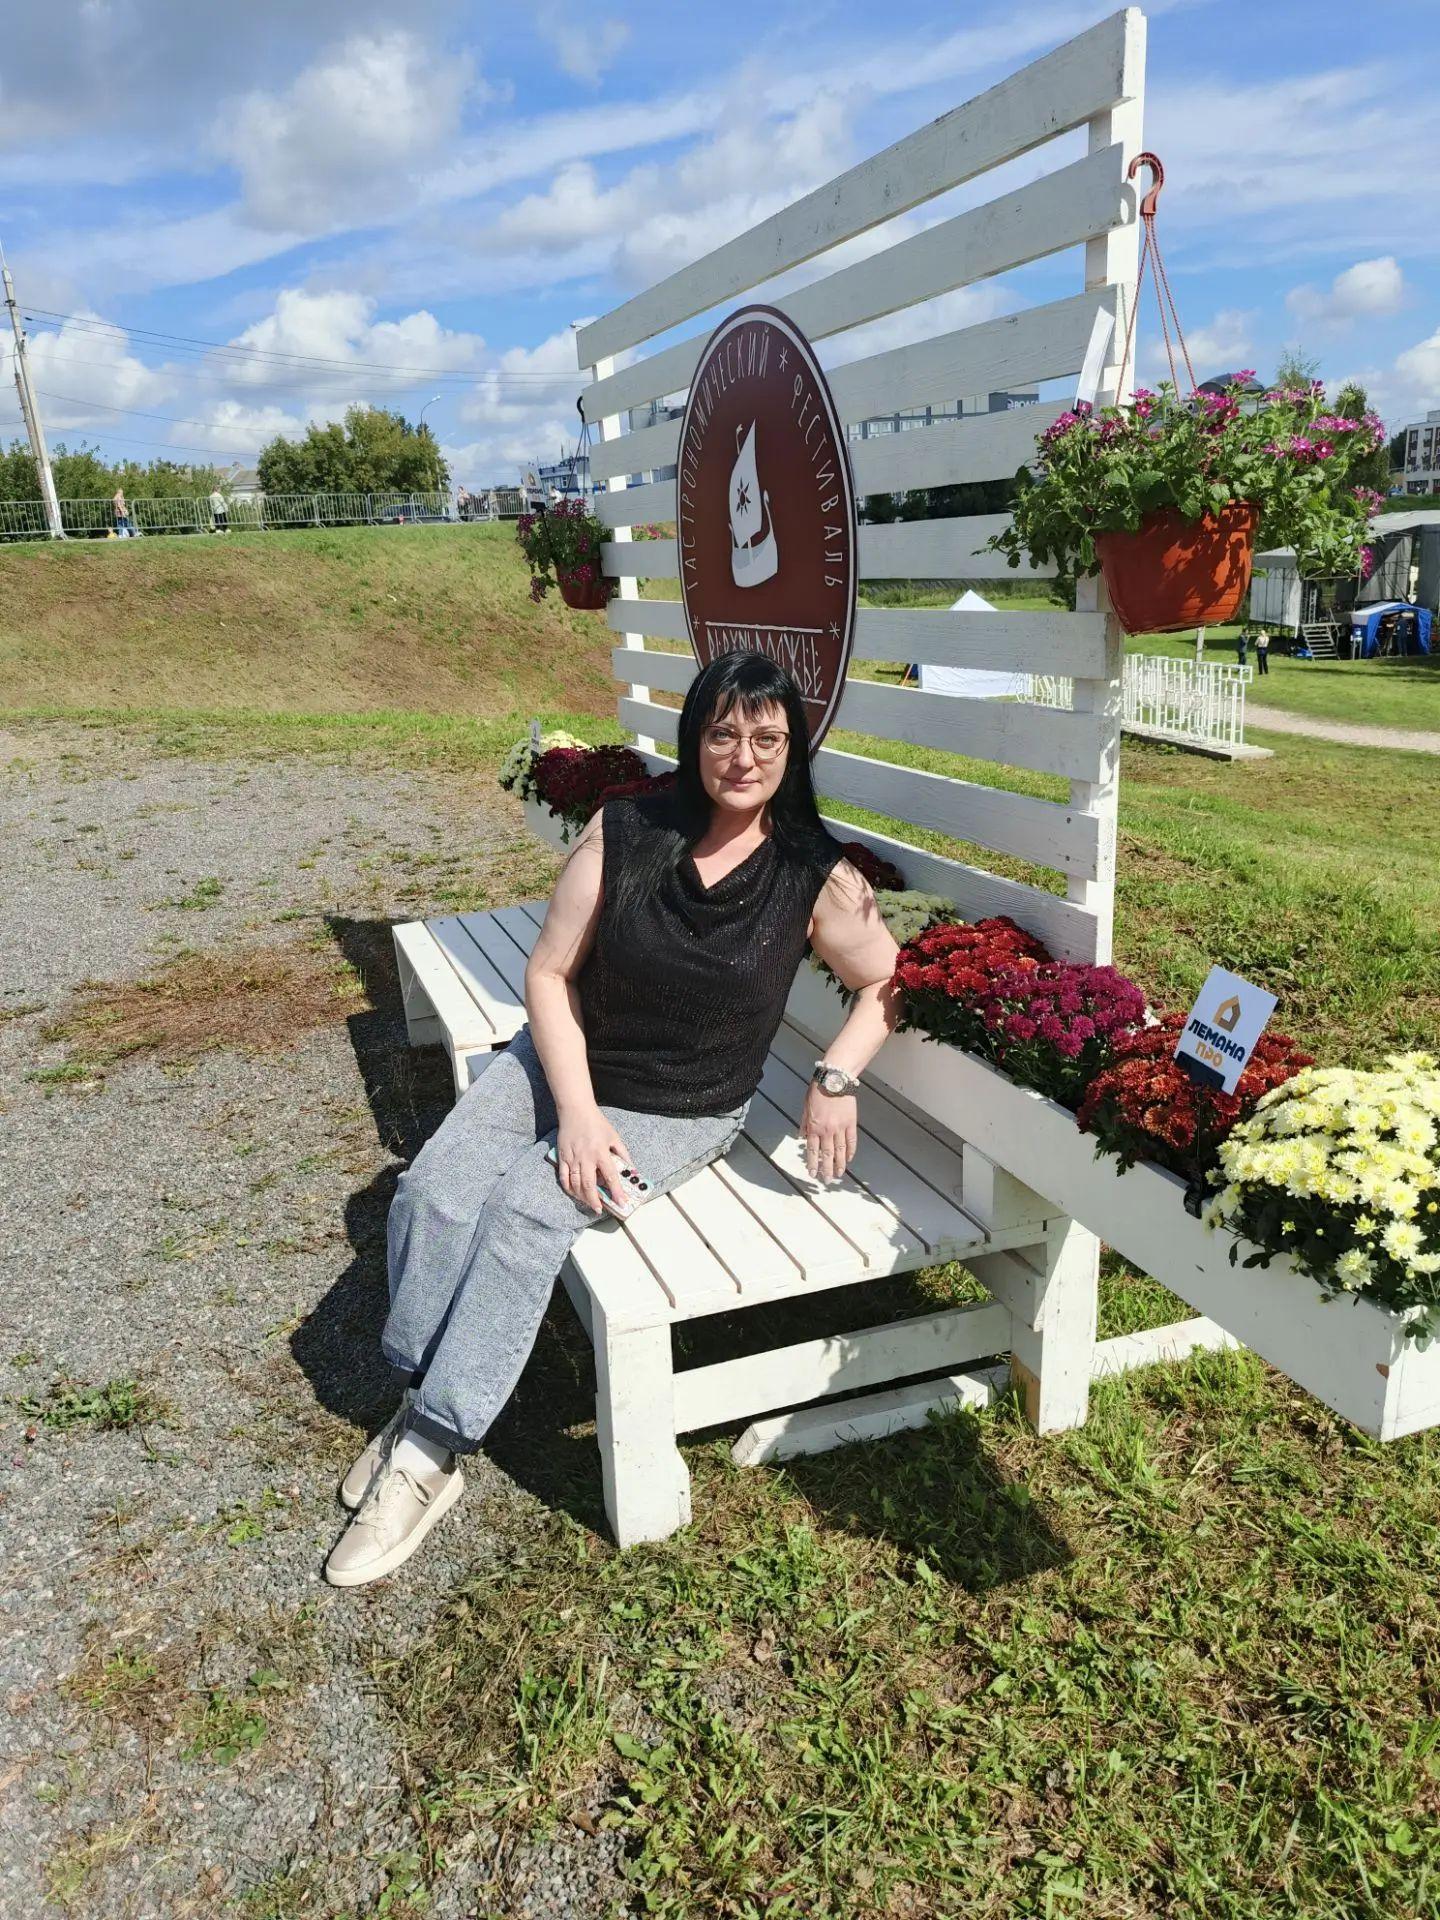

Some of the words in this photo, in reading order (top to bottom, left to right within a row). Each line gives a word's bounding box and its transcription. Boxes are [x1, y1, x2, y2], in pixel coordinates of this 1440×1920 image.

[681, 326, 770, 591] ГАСТРОНОМИЧЕСКИЙ
[790, 374, 843, 587] ФЕСТИВАЛЬ
[1188, 1019, 1246, 1063] ЛЕМАНА
[1195, 1040, 1223, 1067] ПРО
